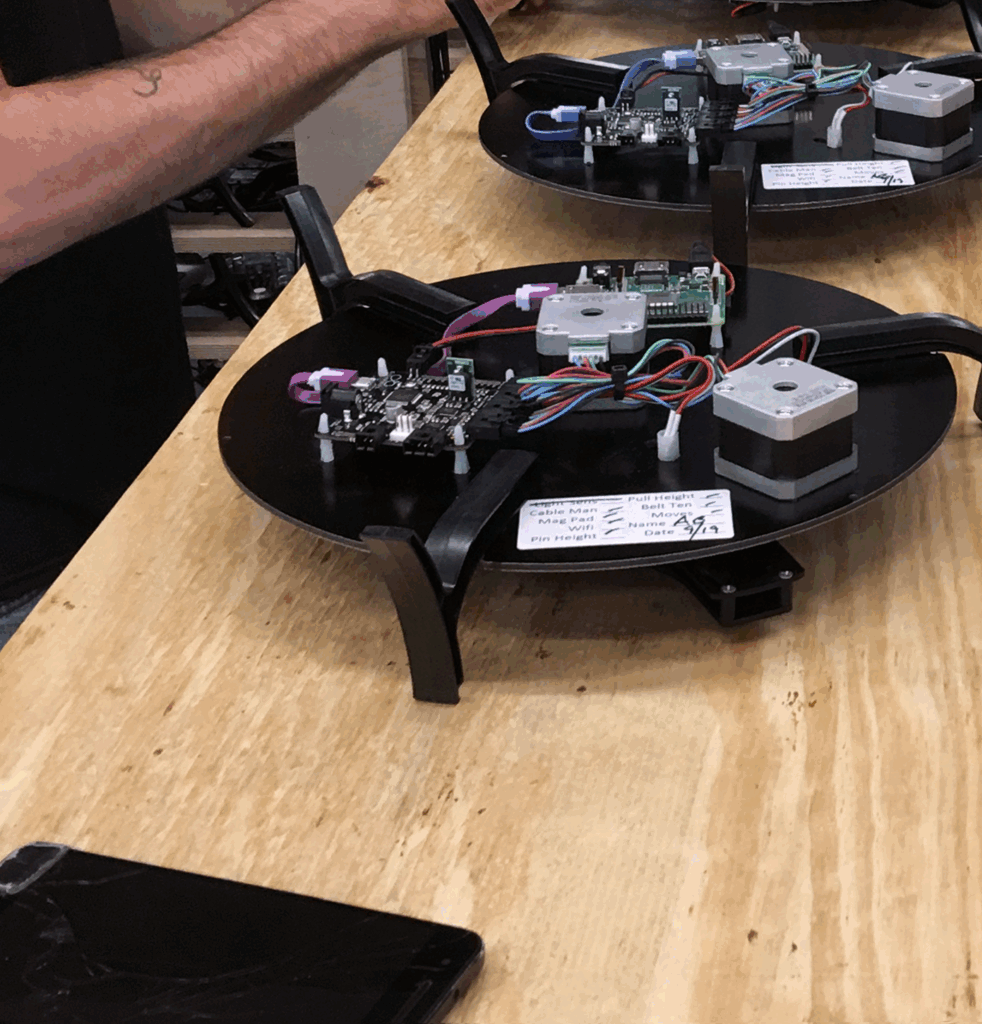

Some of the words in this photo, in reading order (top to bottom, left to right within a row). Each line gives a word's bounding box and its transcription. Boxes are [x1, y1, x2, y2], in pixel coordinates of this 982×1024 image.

[654, 493, 695, 501] Height
[529, 509, 565, 517] Cable
[569, 507, 598, 515] Man
[554, 533, 597, 542] Height
